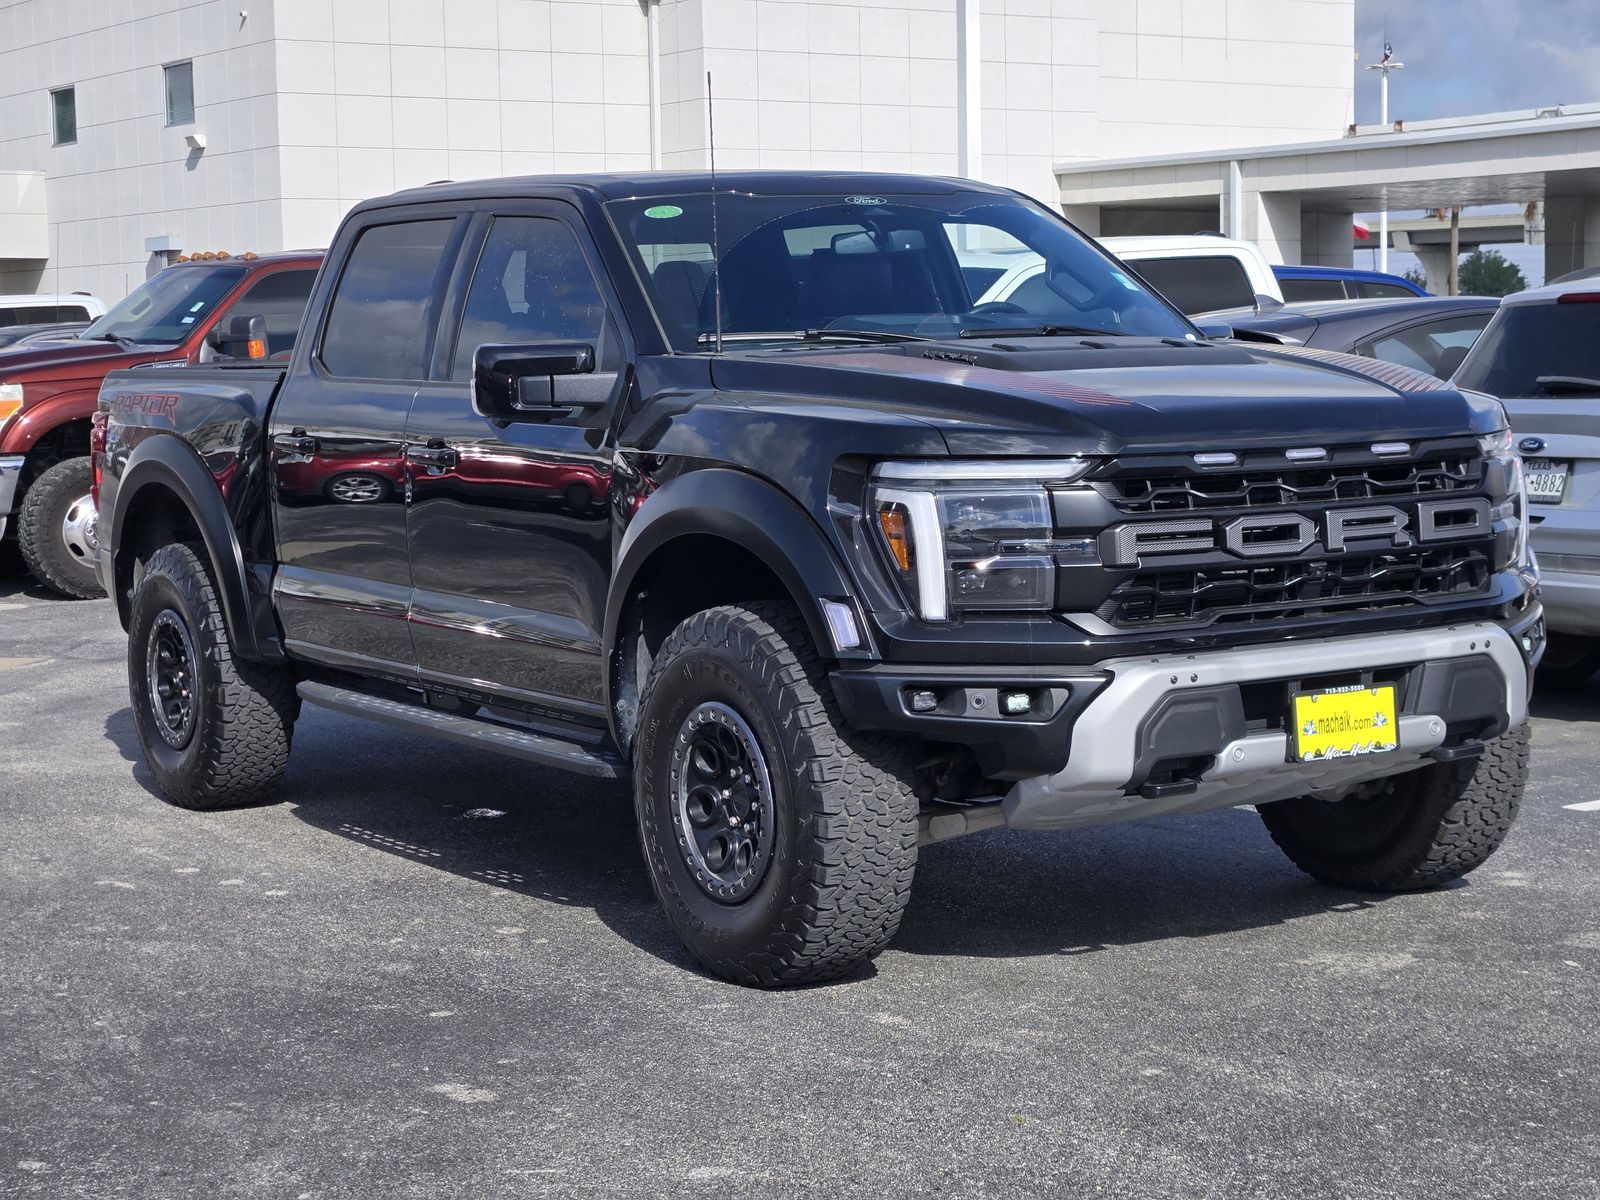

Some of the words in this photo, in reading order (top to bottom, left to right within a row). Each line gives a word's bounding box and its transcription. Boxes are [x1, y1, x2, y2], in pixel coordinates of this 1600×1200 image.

[850, 195, 884, 205] Ford
[116, 392, 179, 427] RAPTOR
[1528, 462, 1552, 471] TEXAS
[1102, 498, 1490, 568] FORD
[1318, 710, 1372, 735] machaik.com
[1324, 745, 1350, 760] Mac
[1350, 741, 1375, 756] Haik
